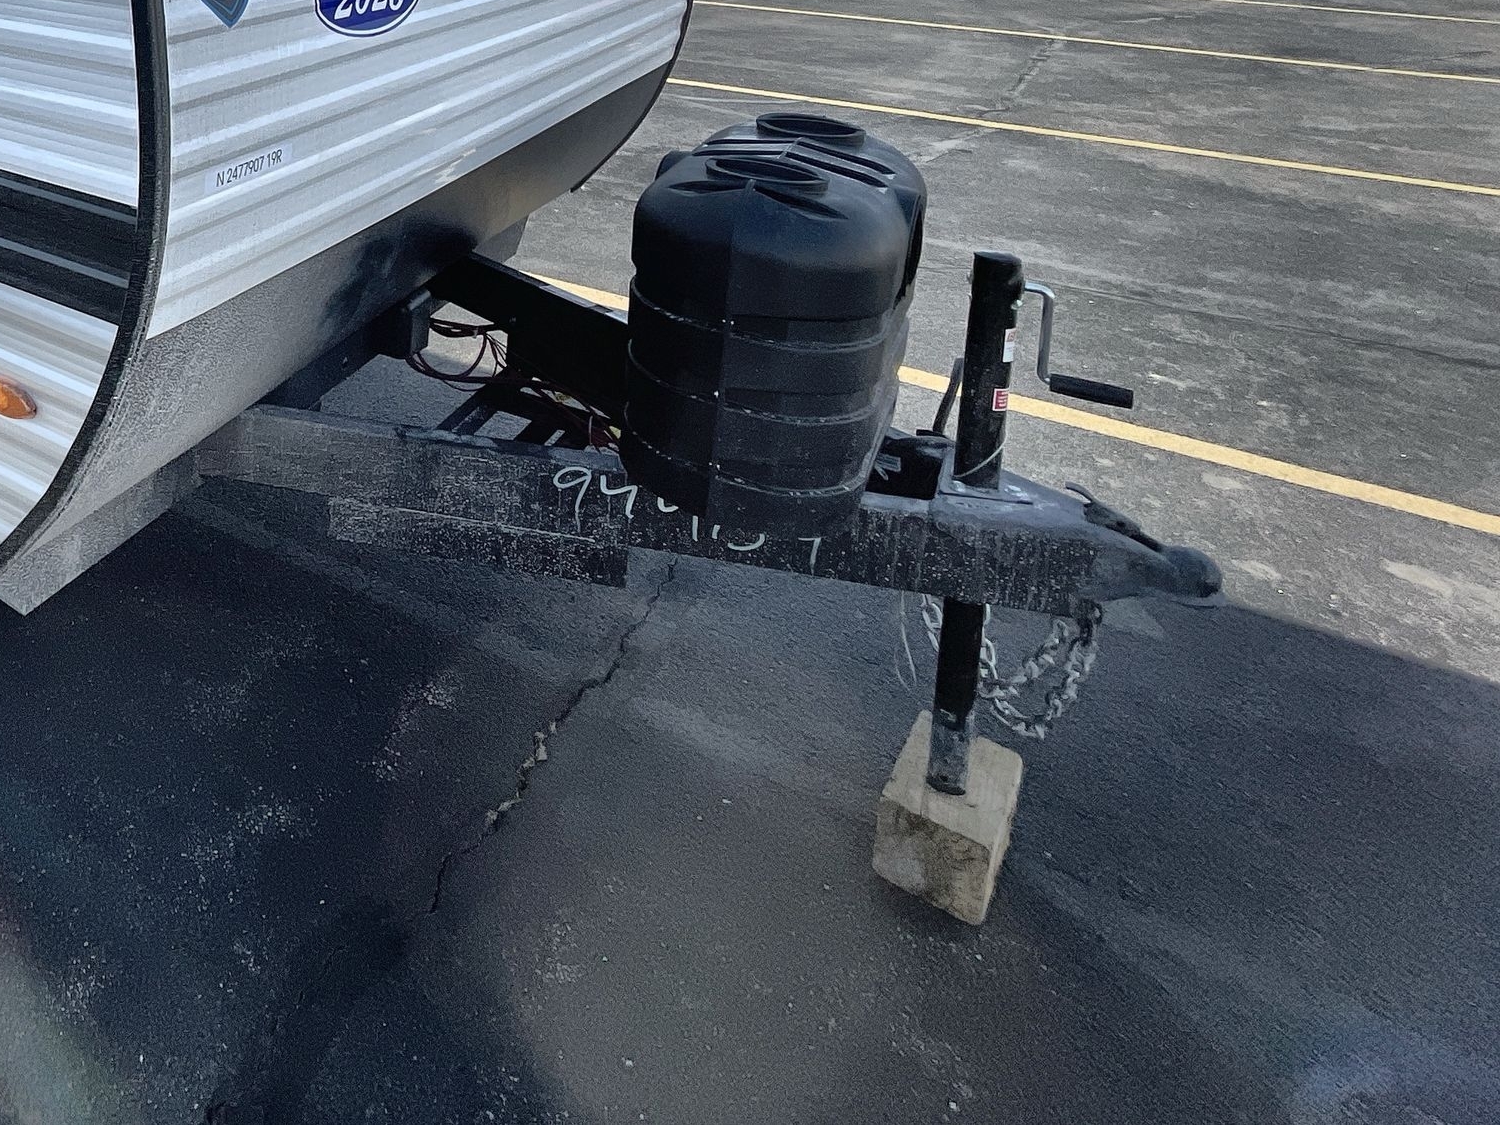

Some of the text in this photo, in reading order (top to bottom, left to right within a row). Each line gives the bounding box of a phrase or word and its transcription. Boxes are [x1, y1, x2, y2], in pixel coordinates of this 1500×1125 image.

[216, 148, 283, 188] N 2477907 19R
